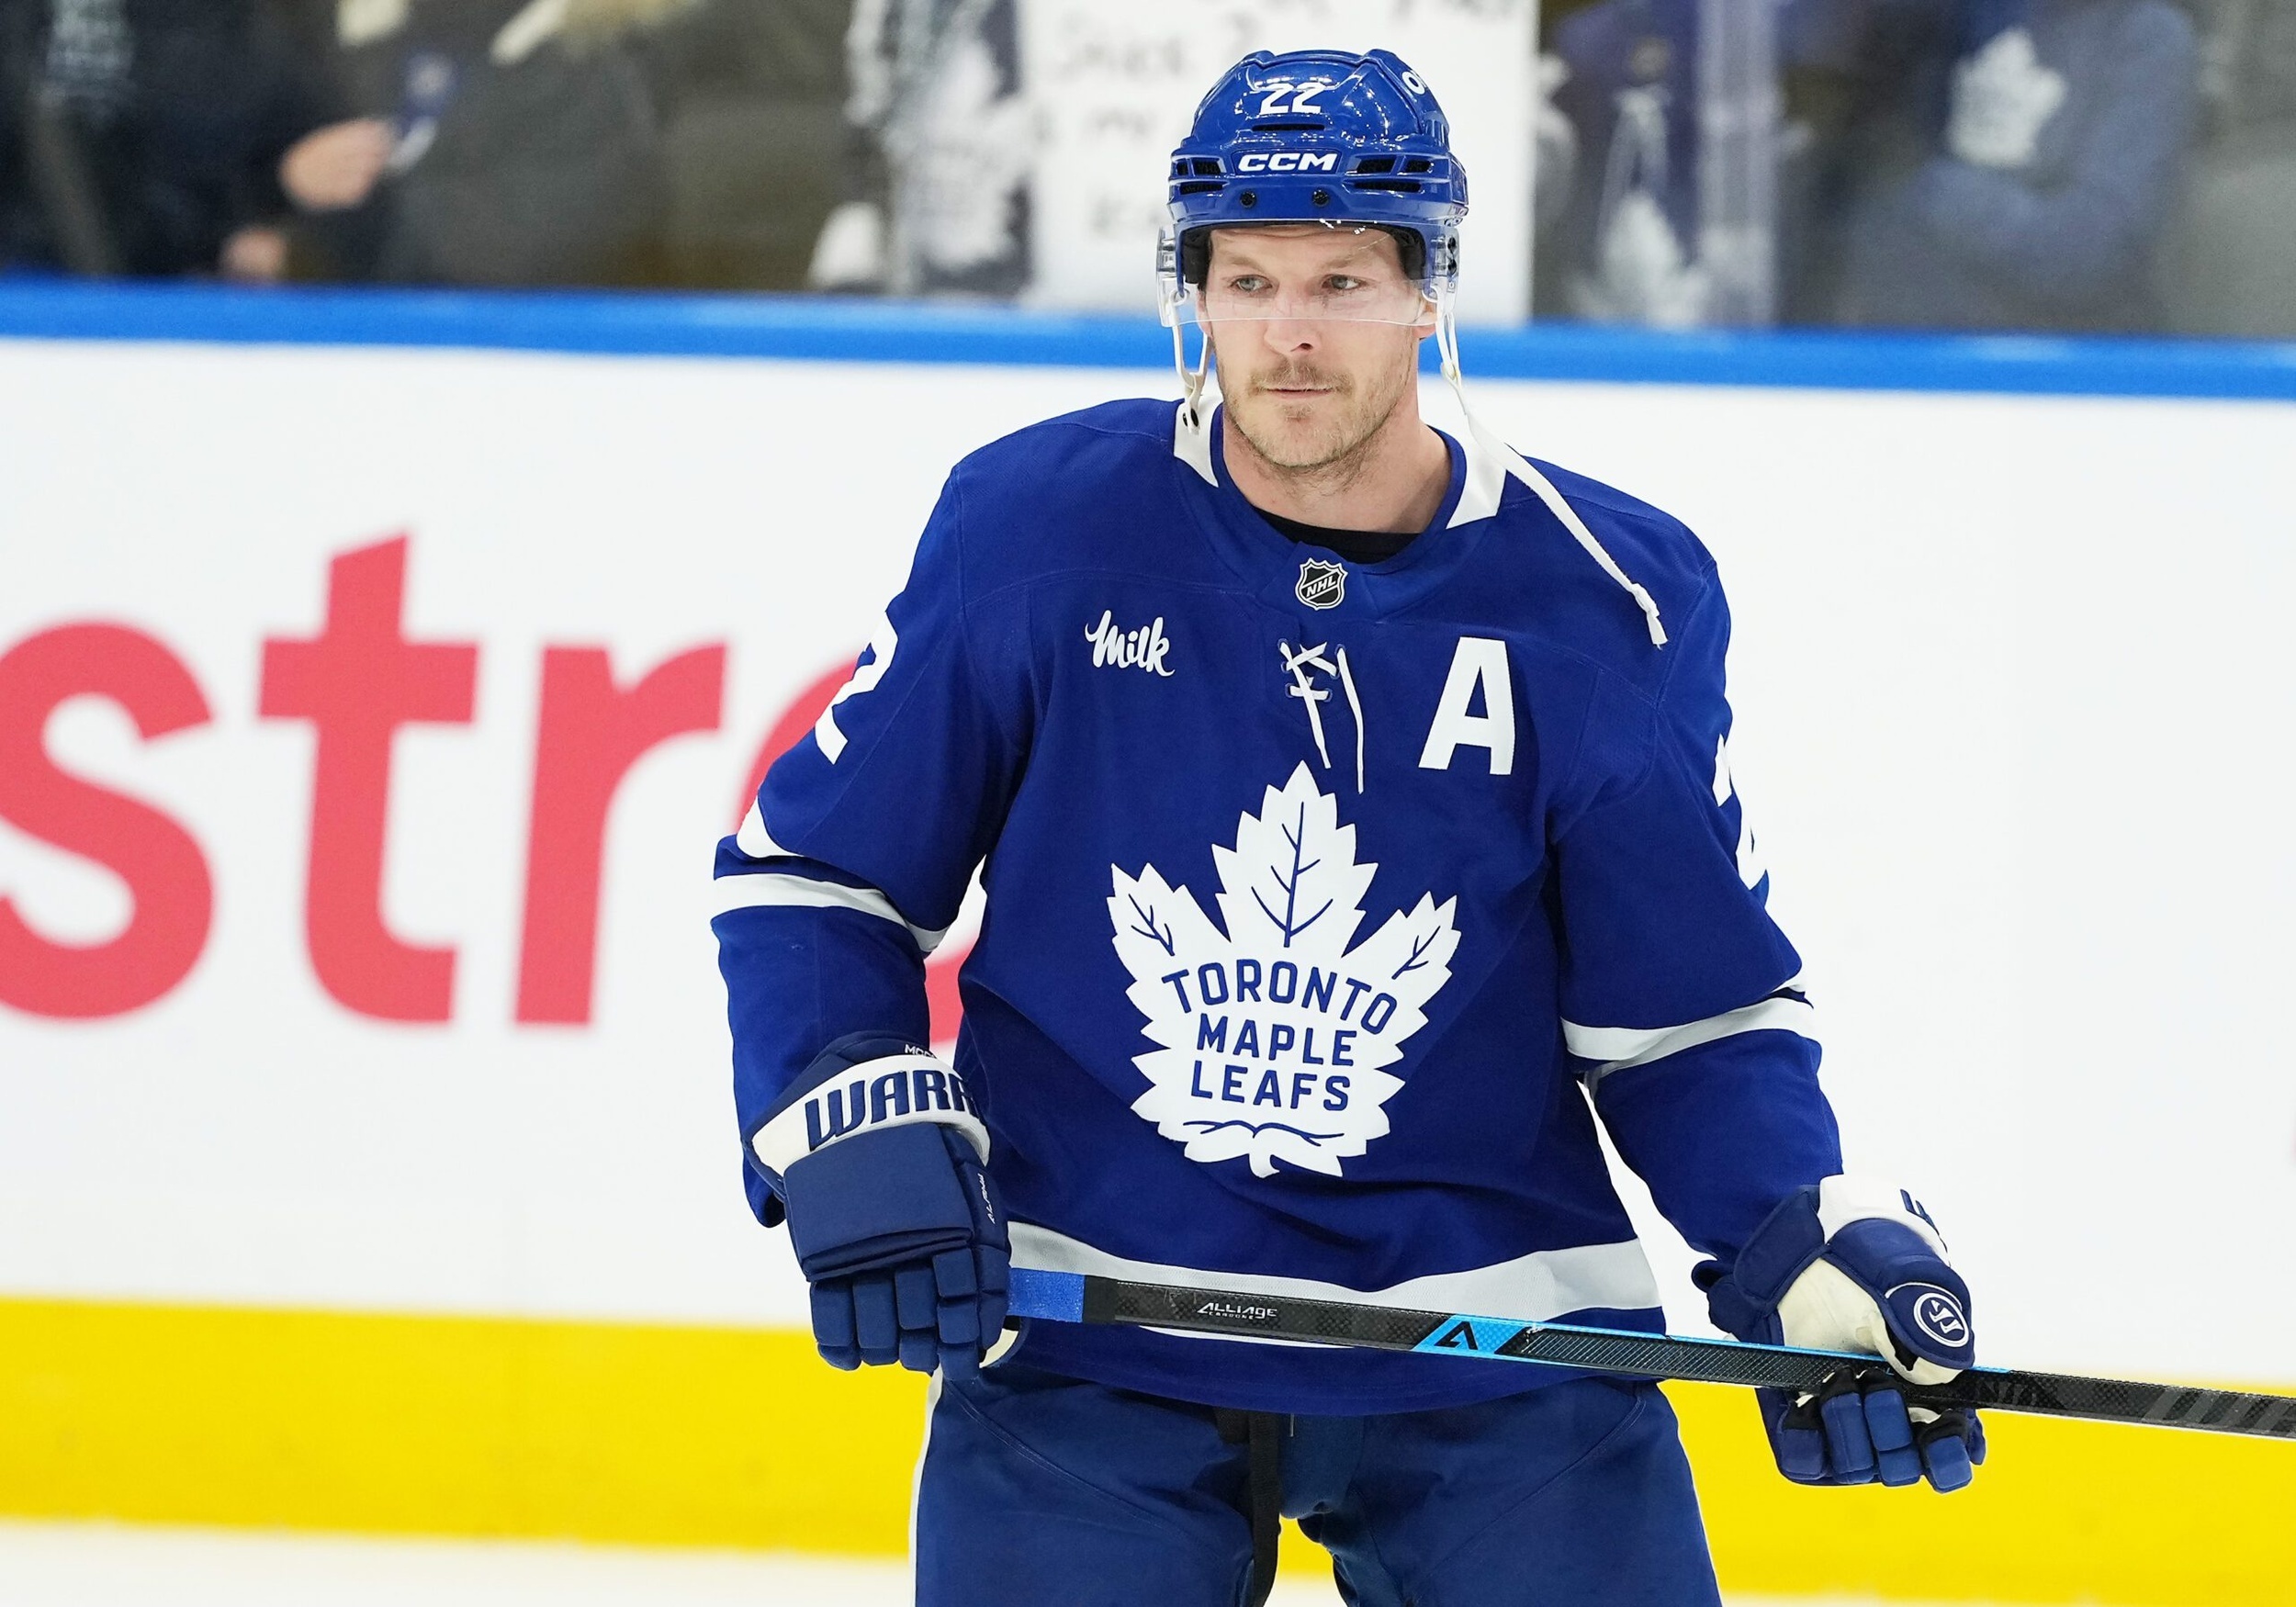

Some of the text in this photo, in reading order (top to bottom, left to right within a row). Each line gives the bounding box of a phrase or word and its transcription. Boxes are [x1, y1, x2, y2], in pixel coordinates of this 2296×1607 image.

[1259, 81, 1325, 115] 22
[1238, 152, 1338, 172] CCM
[1306, 575, 1337, 598] NHL
[1085, 609, 1176, 677] Milk
[1418, 635, 1516, 776] A
[0, 531, 979, 1045] str
[1161, 958, 1398, 1036] TORONTO
[1196, 1012, 1358, 1067] MAPLE
[1190, 1060, 1351, 1111] LEAFS
